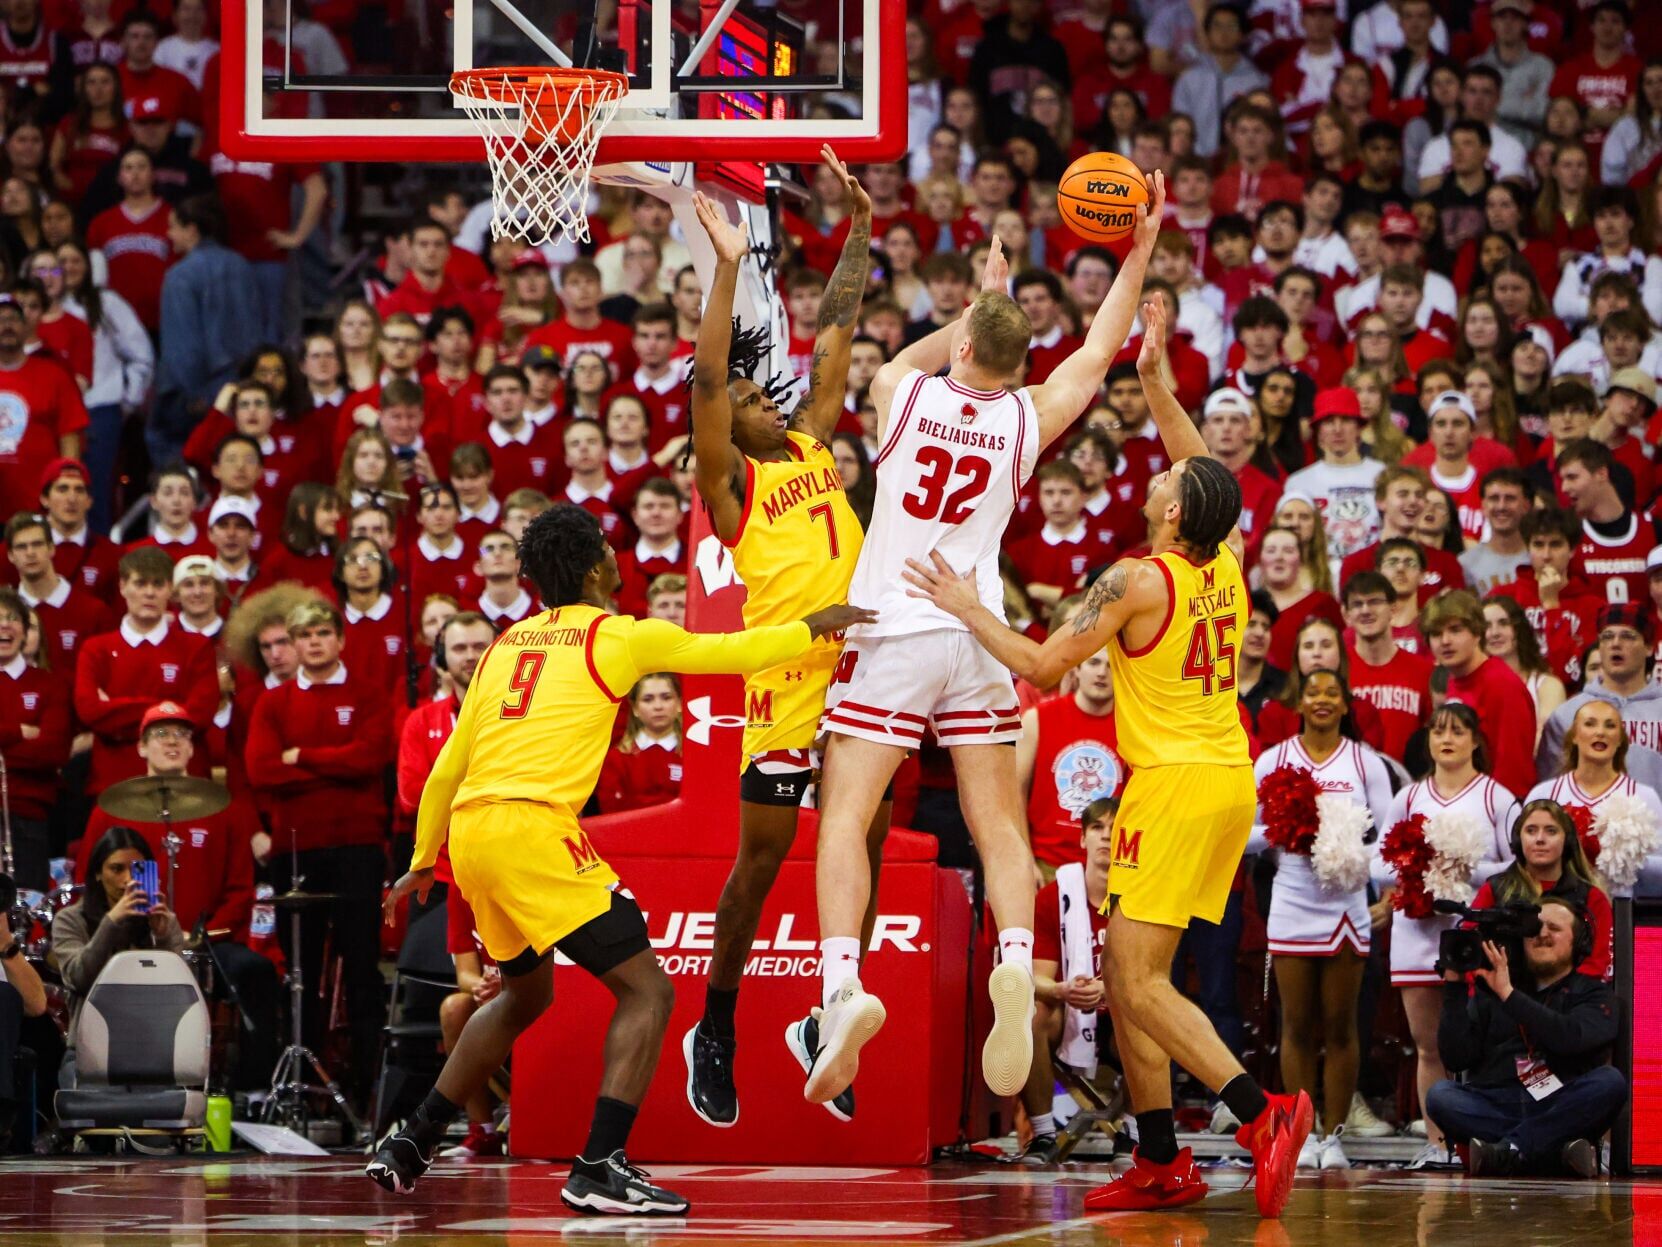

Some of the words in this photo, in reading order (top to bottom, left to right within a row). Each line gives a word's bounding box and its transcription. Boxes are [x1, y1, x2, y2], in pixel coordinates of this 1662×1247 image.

[1087, 181, 1130, 198] NCAA
[1075, 204, 1134, 227] Wilson
[917, 417, 1006, 451] BIELIAUSKAS
[761, 467, 844, 526] MARYLAN
[902, 445, 992, 525] 32
[808, 500, 840, 560] 7
[1202, 567, 1215, 591] M
[499, 628, 587, 648] WASHINGTON
[1181, 612, 1237, 696] 45
[499, 649, 548, 720] 9
[748, 688, 775, 723] M
[560, 831, 599, 870] M
[1114, 827, 1144, 864] M
[656, 955, 713, 976] PORT
[743, 956, 824, 977] MEDICI
